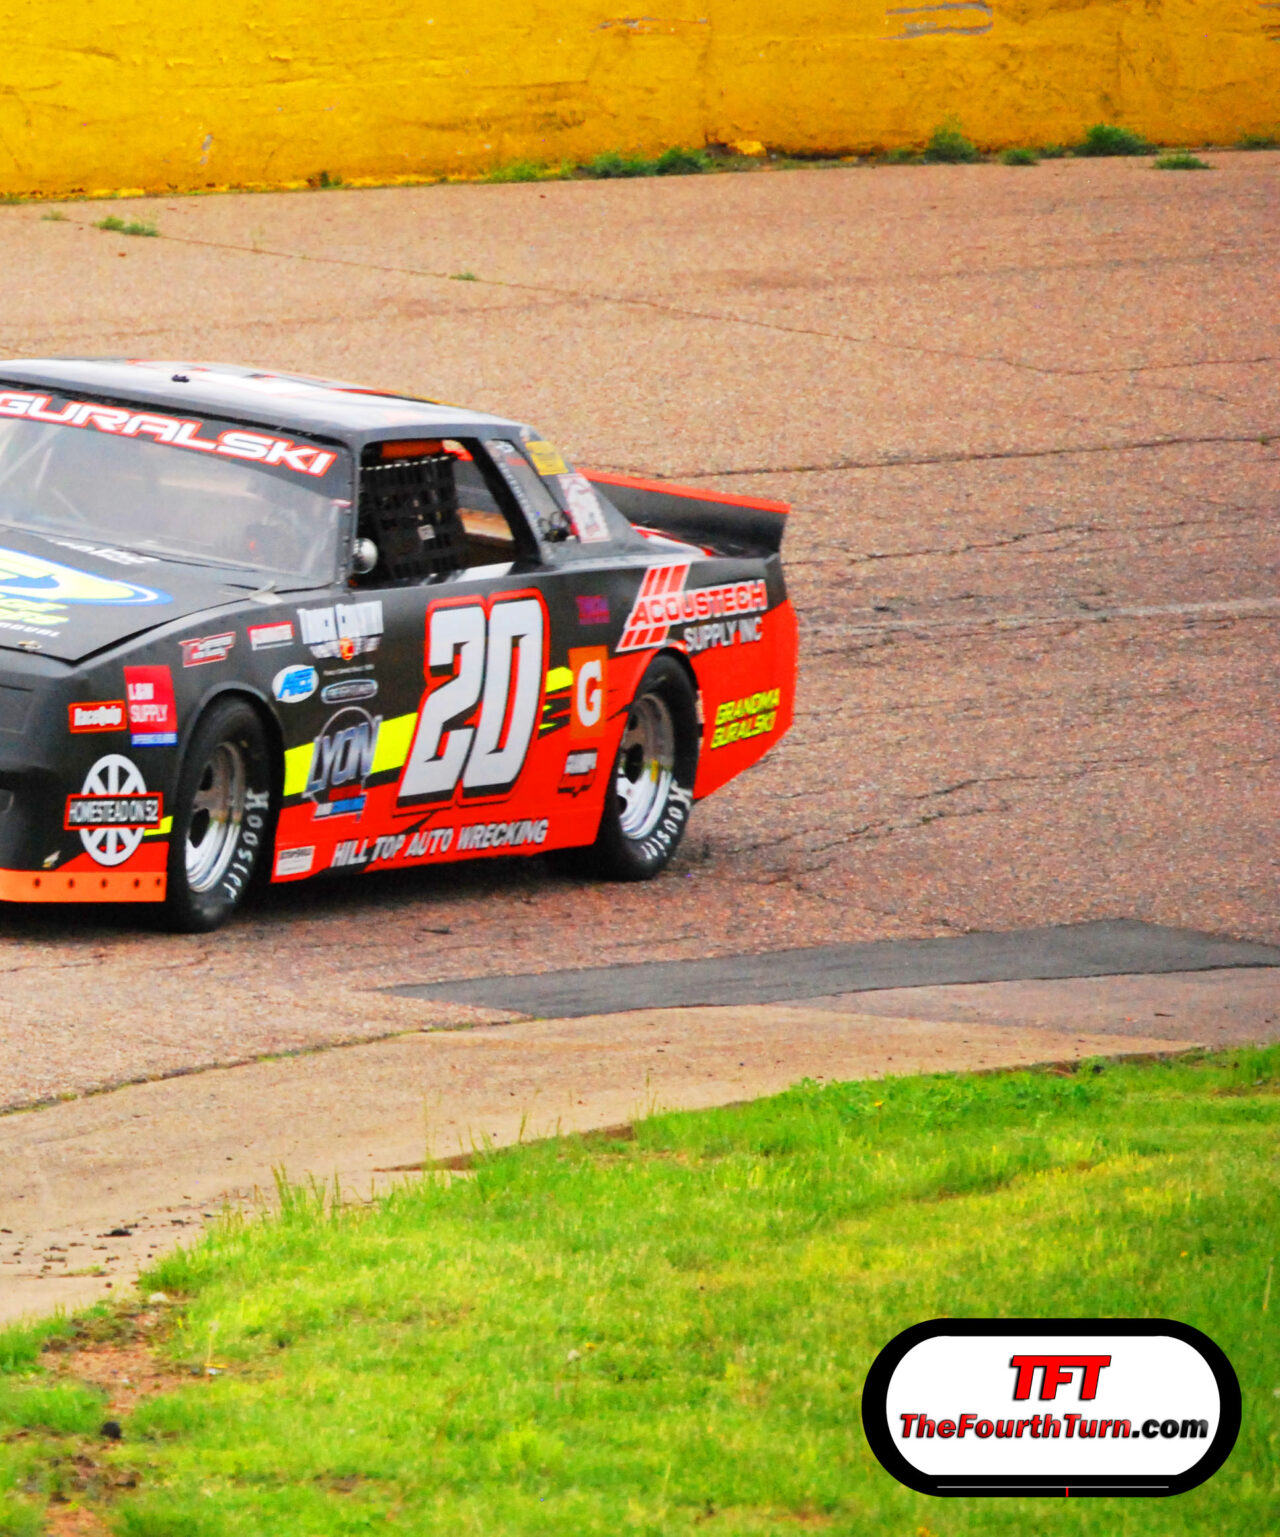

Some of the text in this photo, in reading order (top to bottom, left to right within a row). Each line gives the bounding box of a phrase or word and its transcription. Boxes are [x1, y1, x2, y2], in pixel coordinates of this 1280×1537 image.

[625, 578, 769, 630] ACOUSTECH
[683, 615, 763, 652] SUPPLY INC
[130, 703, 169, 723] SUPPLY
[394, 592, 548, 808] 20
[576, 659, 602, 727] G
[714, 687, 780, 726] GRANDMA
[710, 710, 777, 750] GURALSKI
[302, 714, 383, 799] LYON
[68, 799, 159, 823] HOMESTEAD ON 52
[330, 837, 370, 868] HILL
[370, 832, 407, 863] TOP
[404, 827, 454, 858] AUTO
[456, 818, 550, 851] WRECKING
